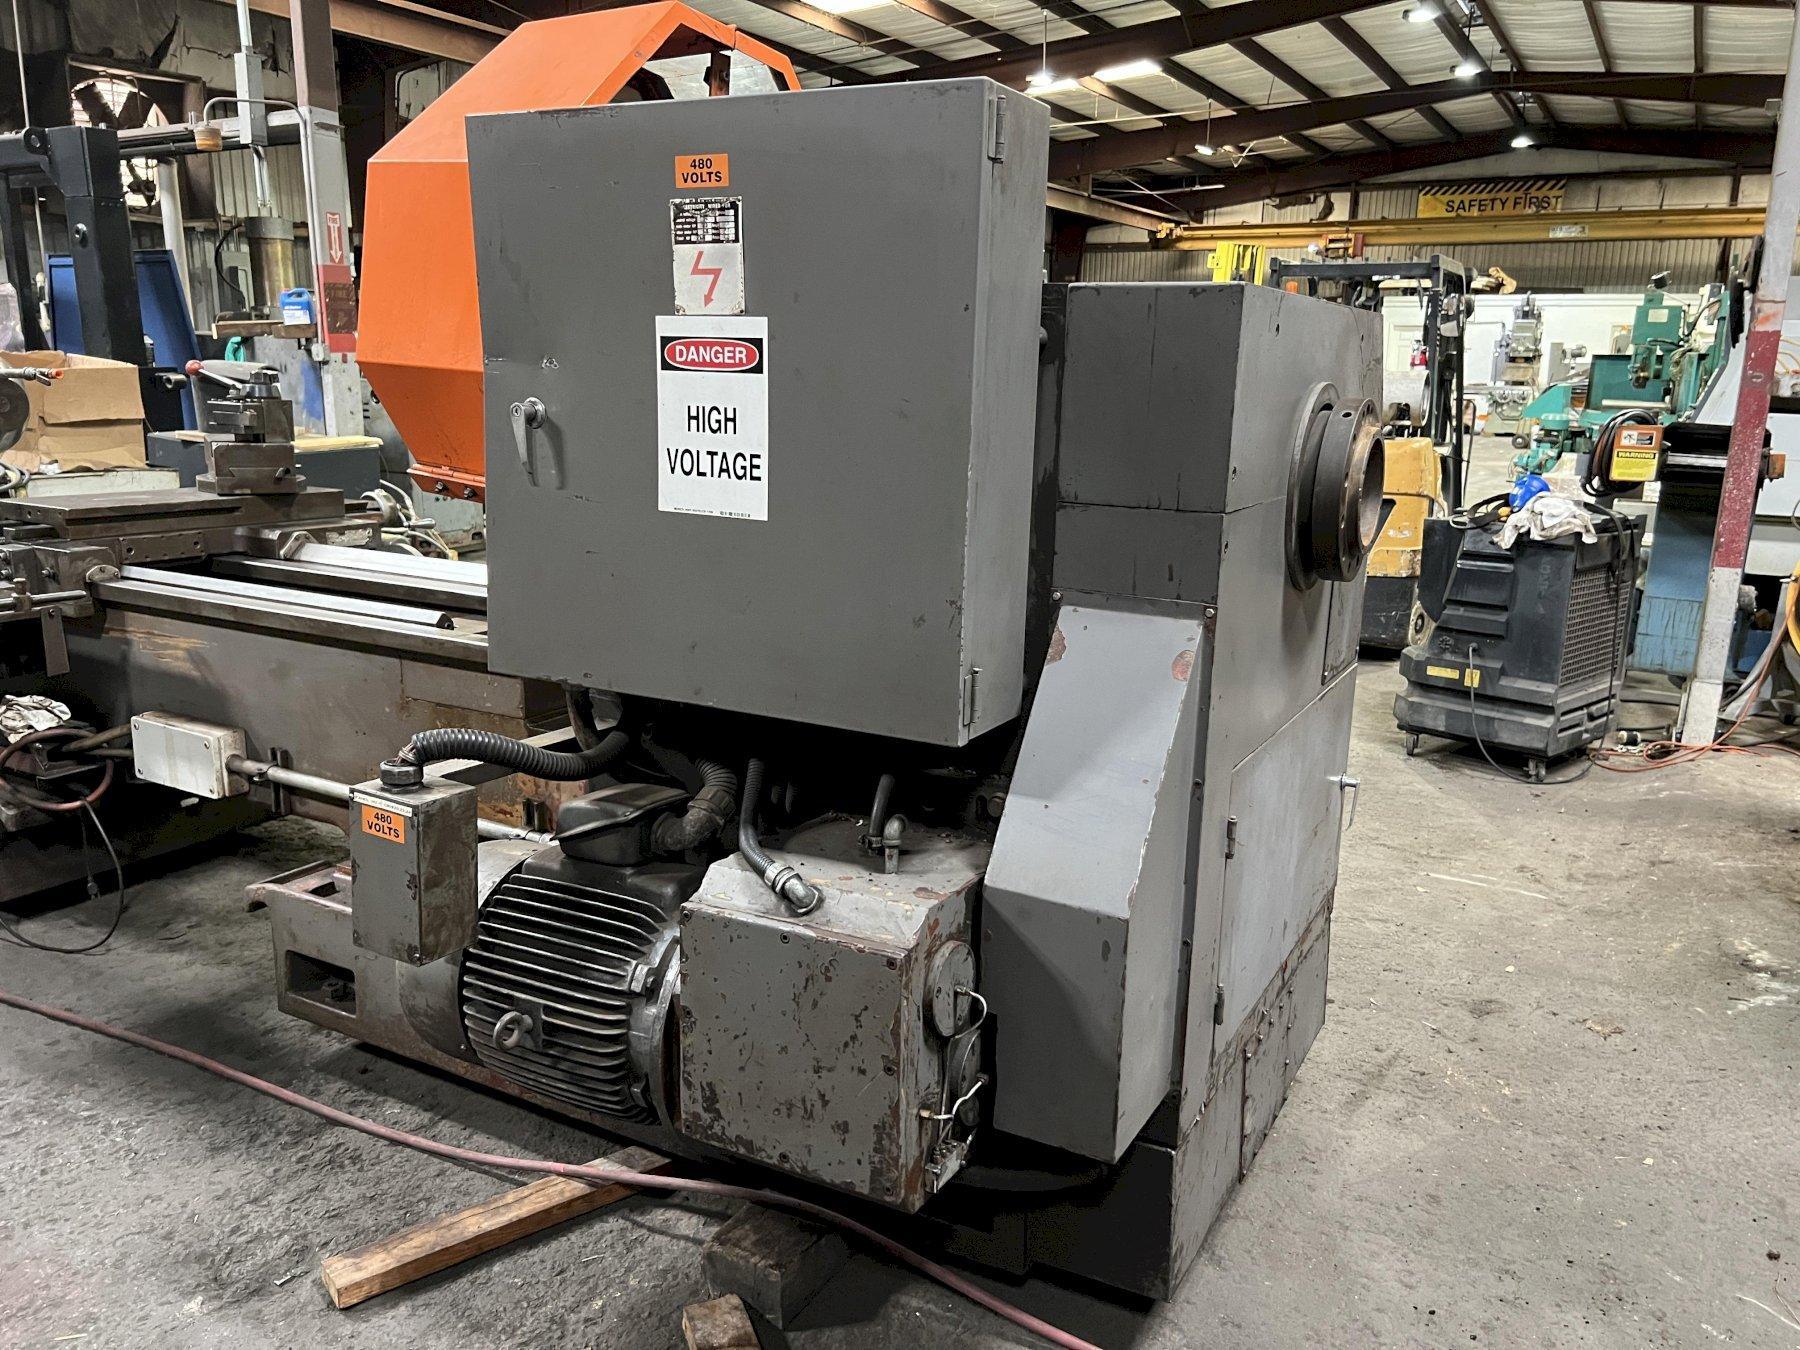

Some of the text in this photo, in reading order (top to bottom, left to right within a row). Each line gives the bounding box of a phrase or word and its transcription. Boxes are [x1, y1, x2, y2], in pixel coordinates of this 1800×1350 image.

[690, 158, 712, 169] 480
[681, 170, 723, 184] VOLTS
[1445, 192, 1562, 213] SAFETY FIRST
[675, 345, 747, 364] DANGER
[687, 405, 737, 435] HIGH
[666, 447, 762, 482] VOLTAGE
[1618, 451, 1654, 459] WARNING
[374, 812, 392, 825] 480
[367, 819, 400, 839] VOLTS
